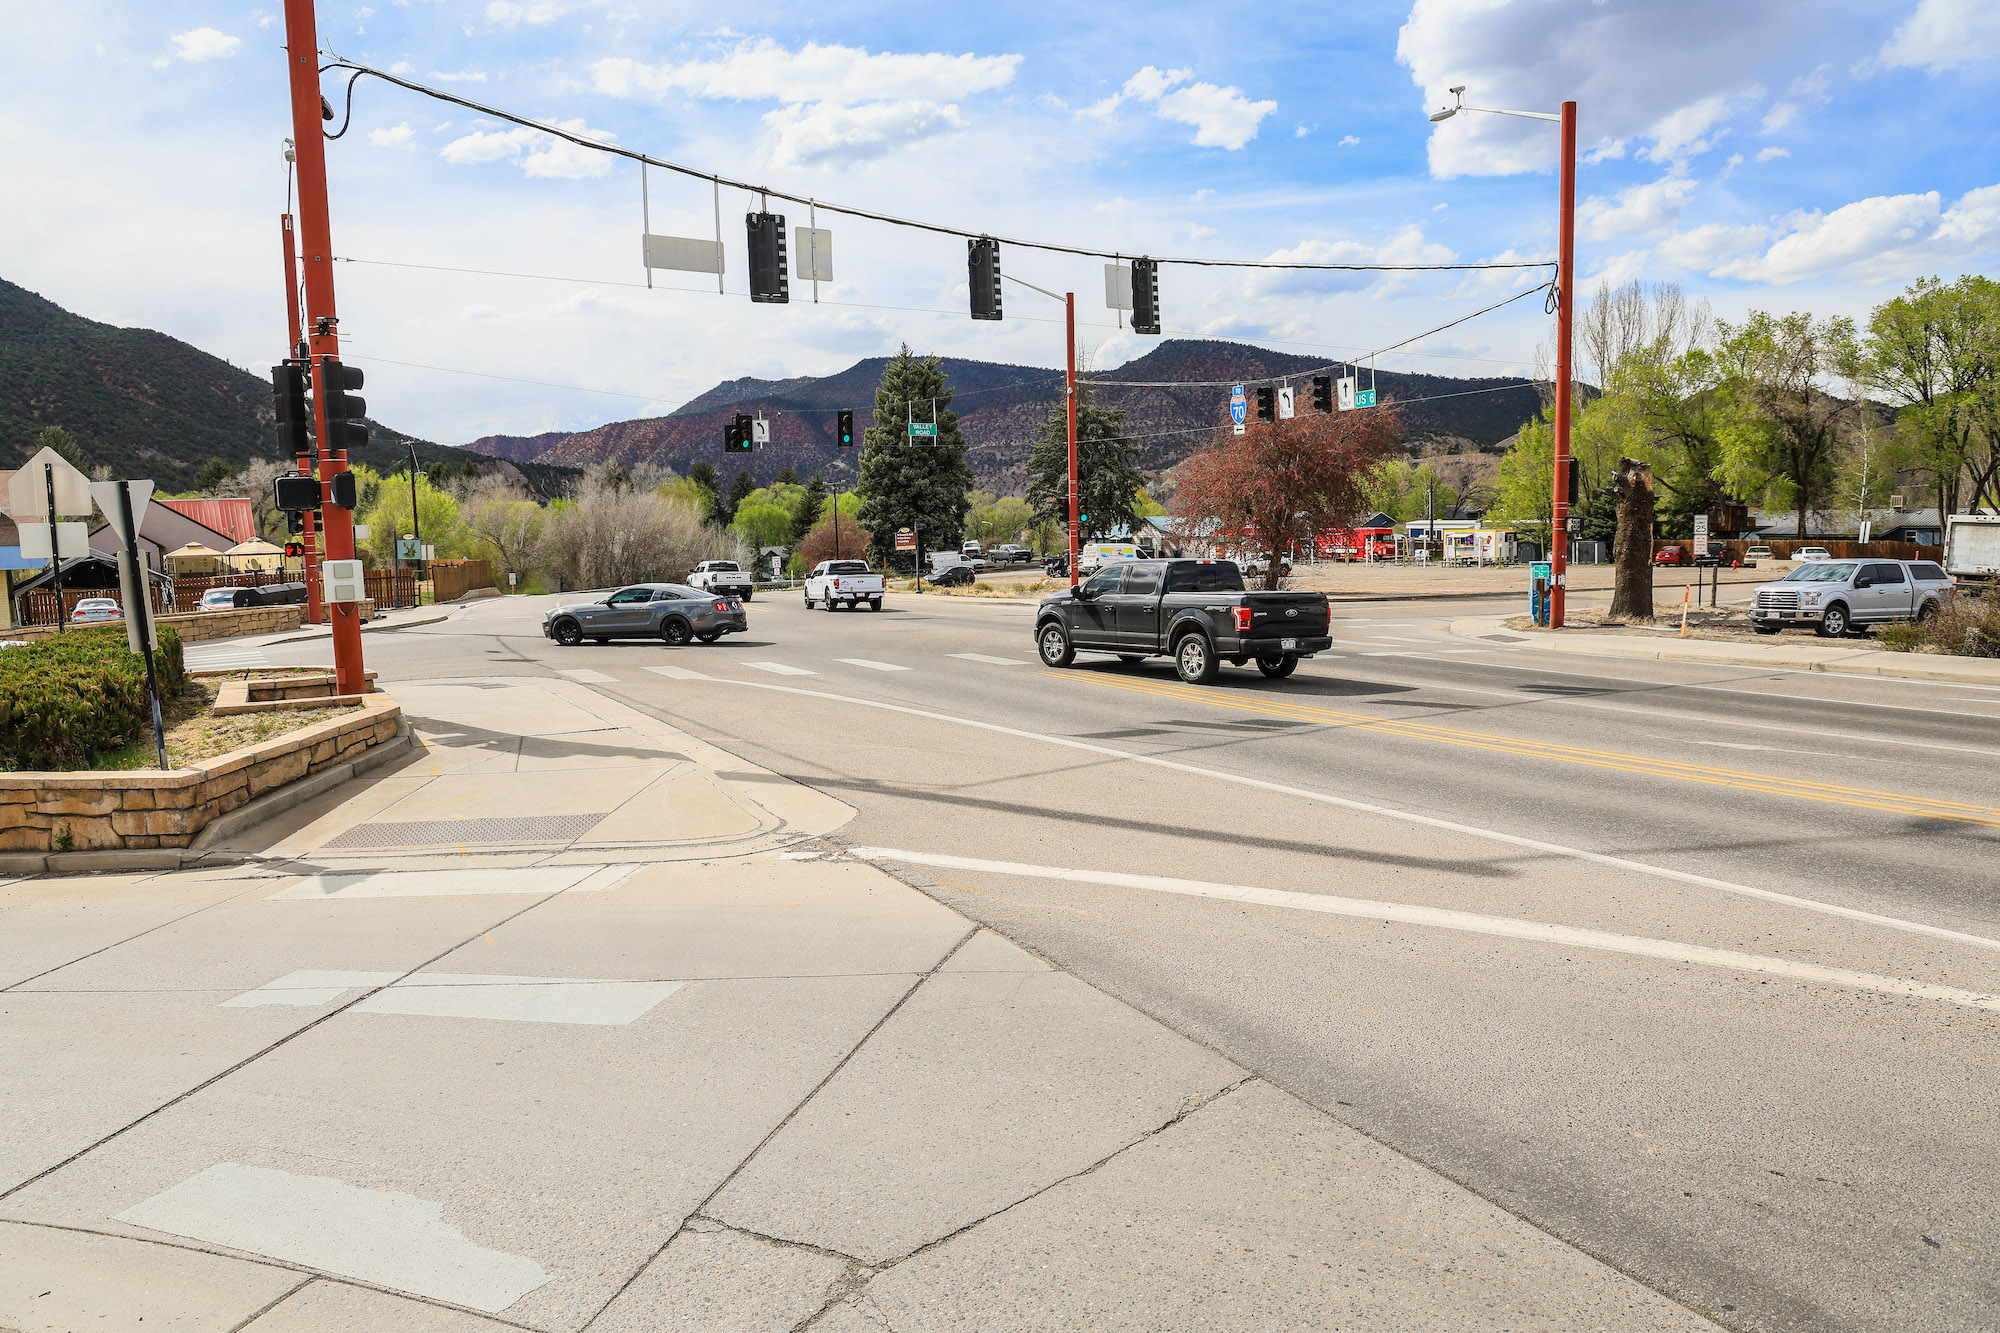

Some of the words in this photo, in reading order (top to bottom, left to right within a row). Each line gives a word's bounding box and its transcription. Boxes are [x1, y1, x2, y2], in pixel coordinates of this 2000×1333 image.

[1356, 393, 1367, 406] US
[1369, 392, 1376, 404] 6
[1233, 405, 1245, 420] 70
[1695, 525, 1707, 533] 25
